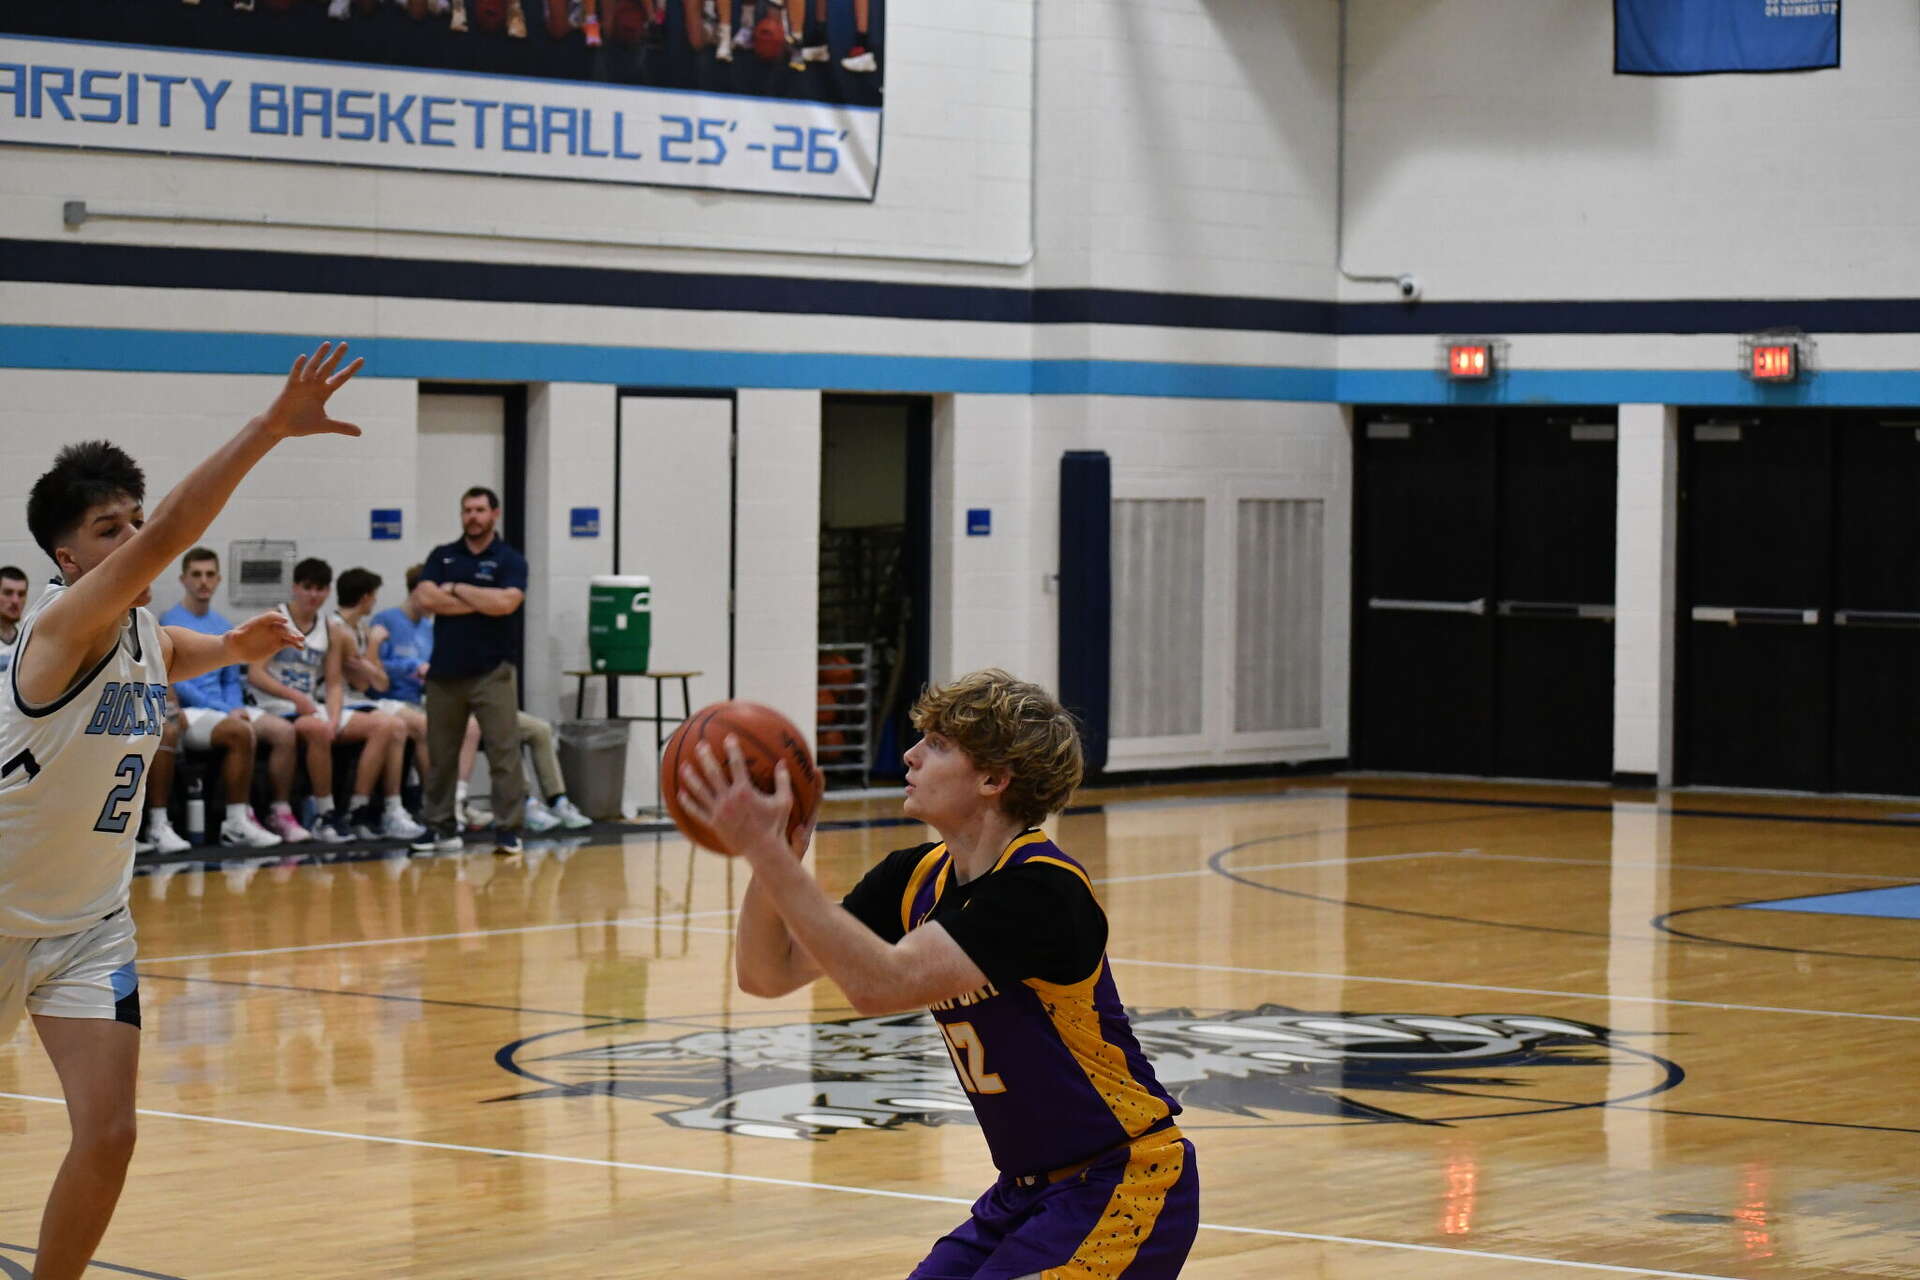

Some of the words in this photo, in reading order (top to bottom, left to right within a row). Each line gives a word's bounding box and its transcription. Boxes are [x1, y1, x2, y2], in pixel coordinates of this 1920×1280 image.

[250, 82, 641, 160] BASKETBALL
[93, 753, 145, 833] 2
[936, 1021, 1007, 1094] 12
